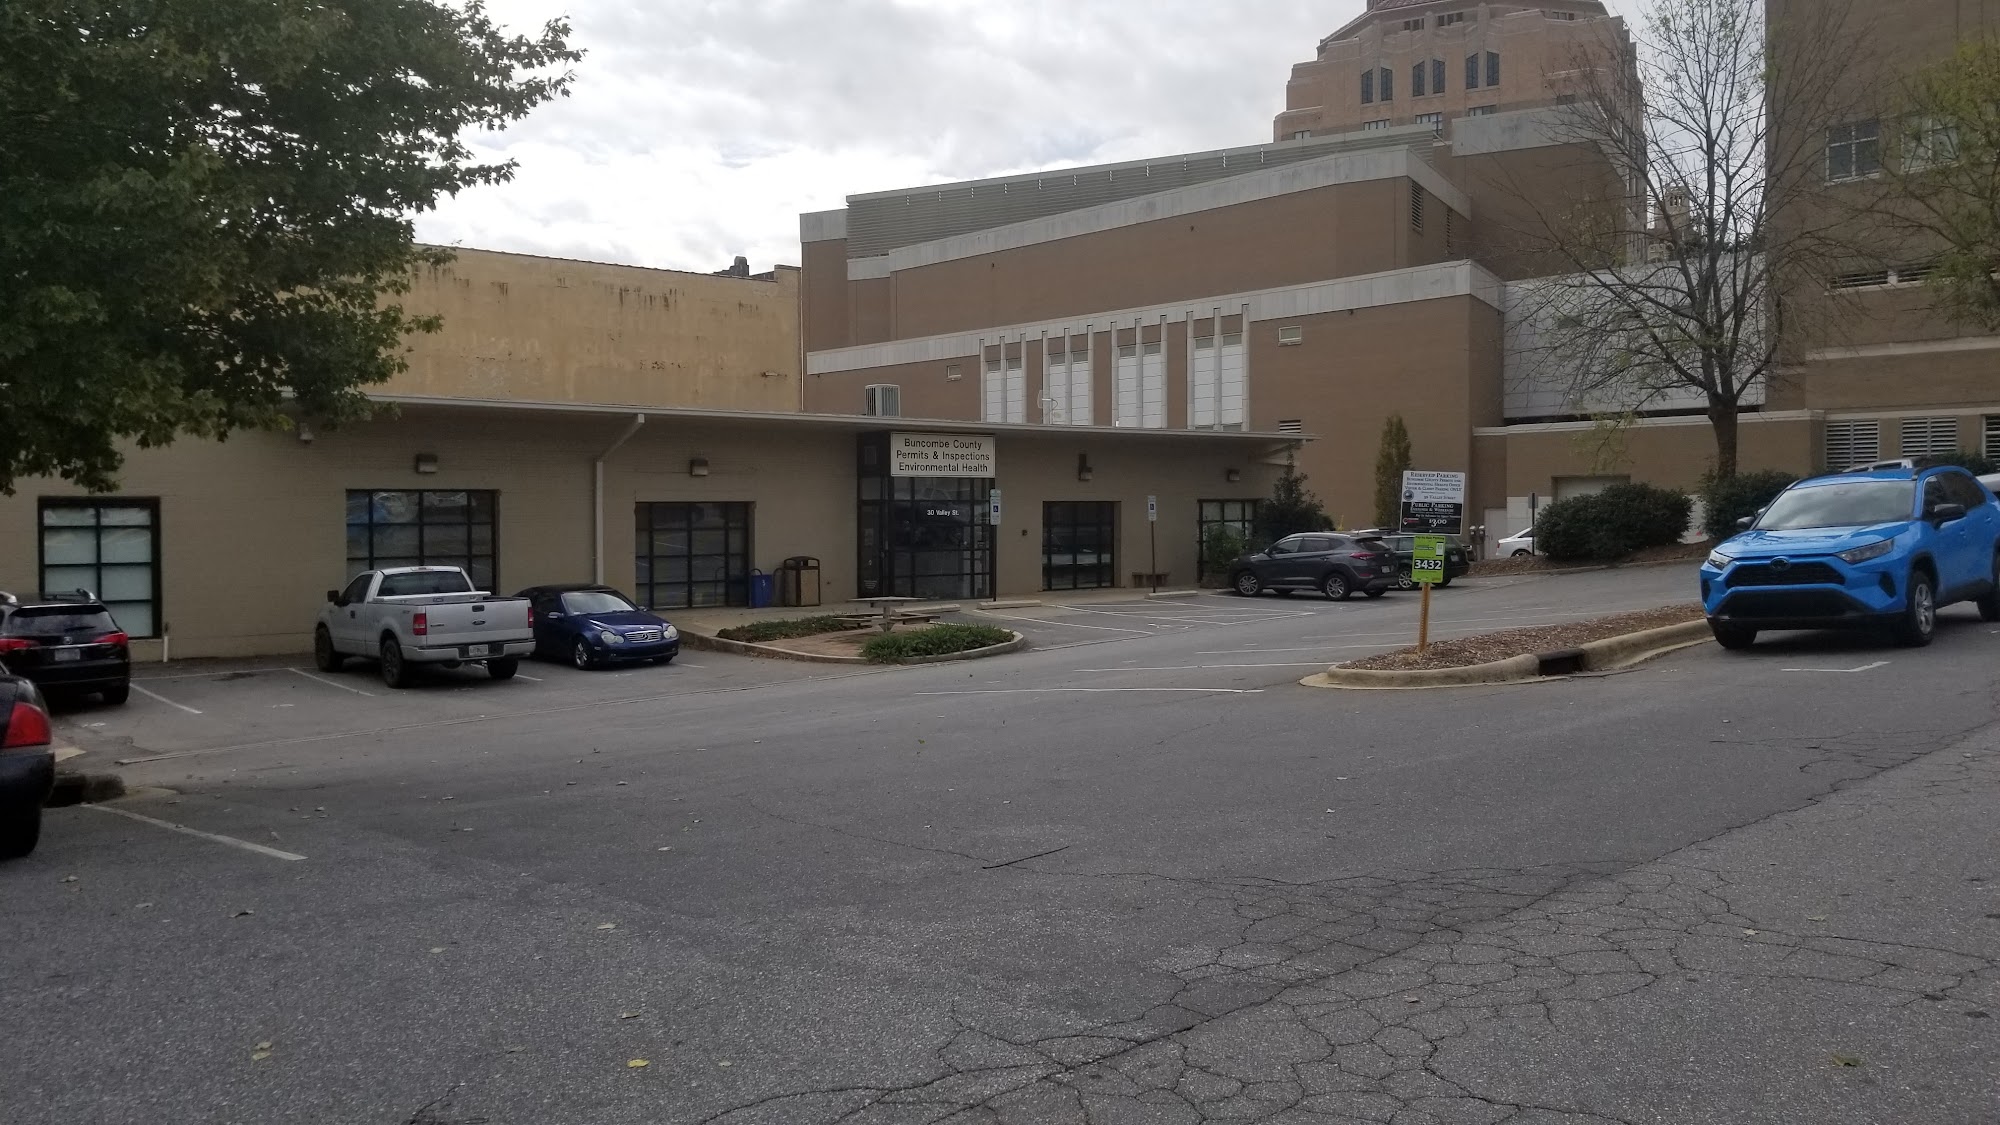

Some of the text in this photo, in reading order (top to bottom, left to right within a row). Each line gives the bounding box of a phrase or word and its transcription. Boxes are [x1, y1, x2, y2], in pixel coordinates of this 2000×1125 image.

[904, 438, 982, 450] Buncombe County
[896, 450, 990, 462] Permits & Inspections
[899, 462, 988, 472] Environmental Health
[935, 509, 951, 517] Valley
[1414, 560, 1442, 570] 3432
